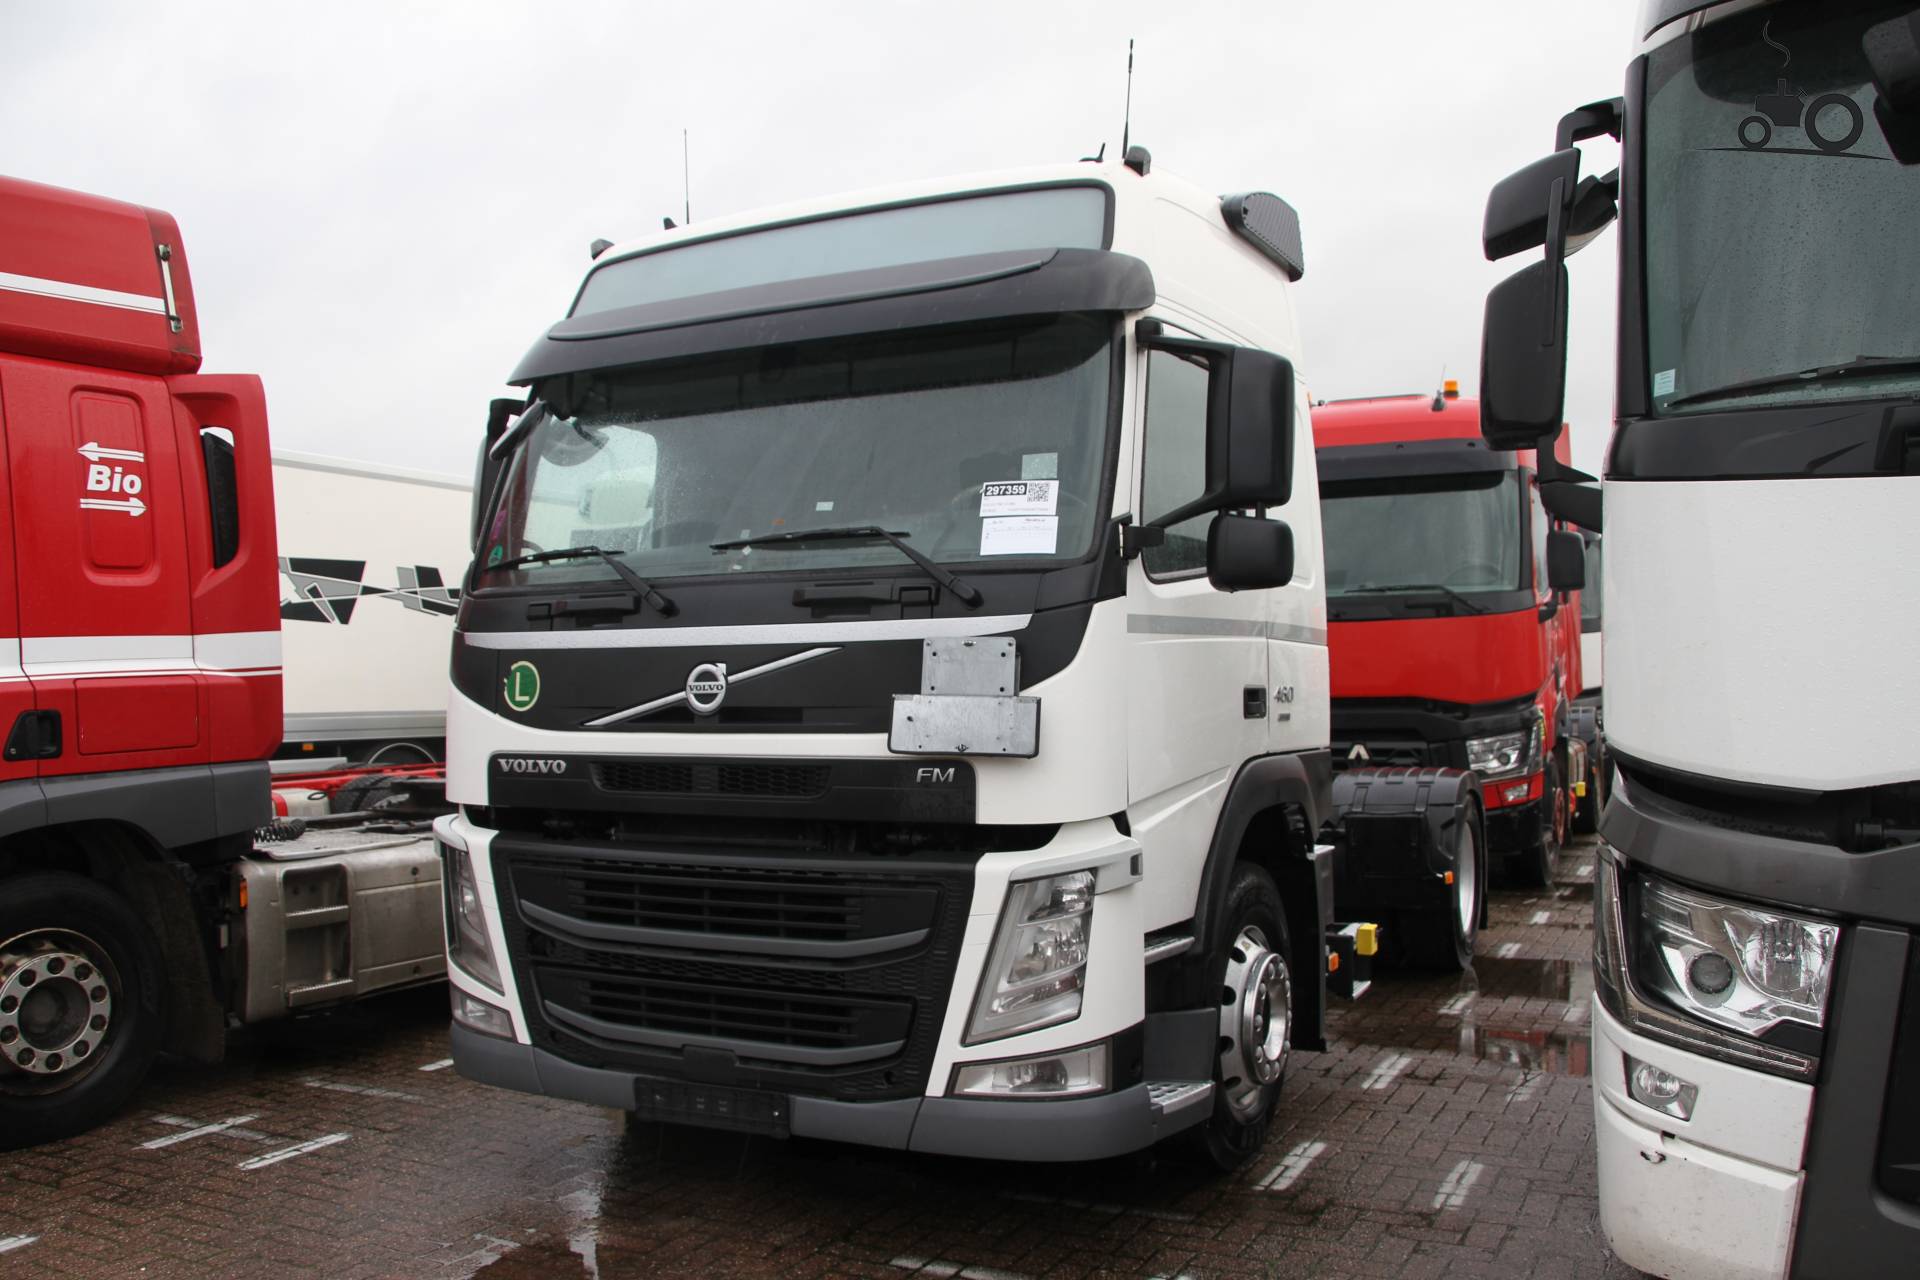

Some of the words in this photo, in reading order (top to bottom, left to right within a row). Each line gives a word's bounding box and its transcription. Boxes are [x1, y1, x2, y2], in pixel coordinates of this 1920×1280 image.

[87, 464, 142, 495] Bio
[985, 485, 1026, 496] 297359
[514, 671, 530, 702] L
[688, 684, 724, 692] VOLVO
[497, 758, 567, 774] VOLVO
[916, 767, 955, 783] FM
